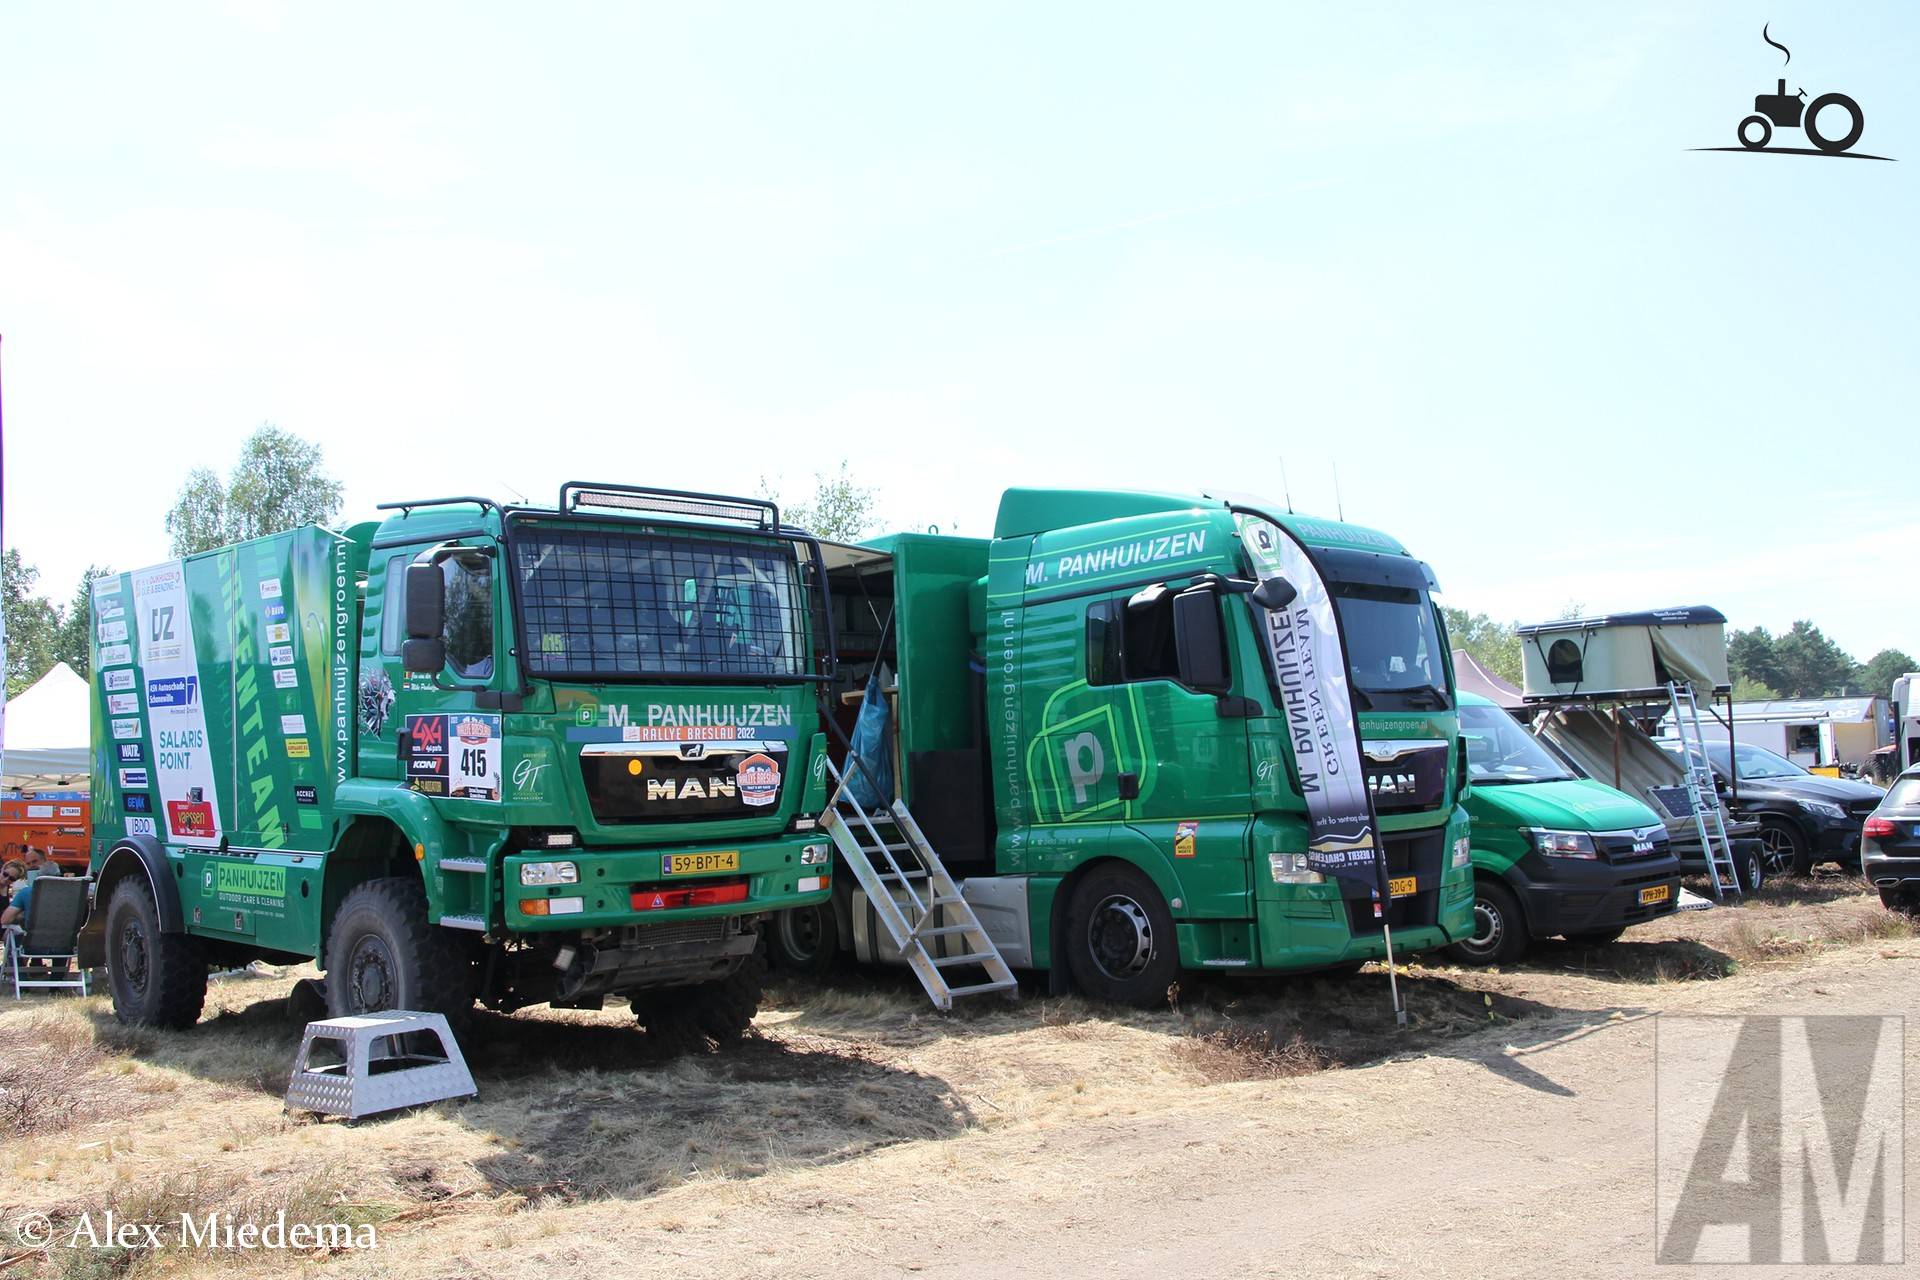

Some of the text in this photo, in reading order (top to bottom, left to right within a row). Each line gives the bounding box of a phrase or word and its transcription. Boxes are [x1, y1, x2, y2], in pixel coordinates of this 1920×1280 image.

[1026, 530, 1206, 584] M. PANHUIJZEN
[334, 540, 349, 783] ww.panhuijzengroen.nl
[608, 704, 637, 727] M.
[647, 704, 791, 726] PANHUIJZEN
[643, 727, 755, 740] RALLYE BRESLAU 2022
[1360, 720, 1428, 731] anhuijzengroen.nl
[160, 730, 203, 749] SALARIS
[160, 752, 191, 770] POINT
[461, 749, 487, 777] 415
[648, 776, 735, 800] MAN
[134, 818, 150, 833] BDO
[1633, 841, 1654, 852] MAN
[675, 854, 734, 871] 59-BPT-4
[219, 868, 284, 891] PANHUIJZEN
[219, 893, 242, 903] OUTDOOR
[243, 895, 256, 905] CARE
[261, 898, 285, 908] CLEANING
